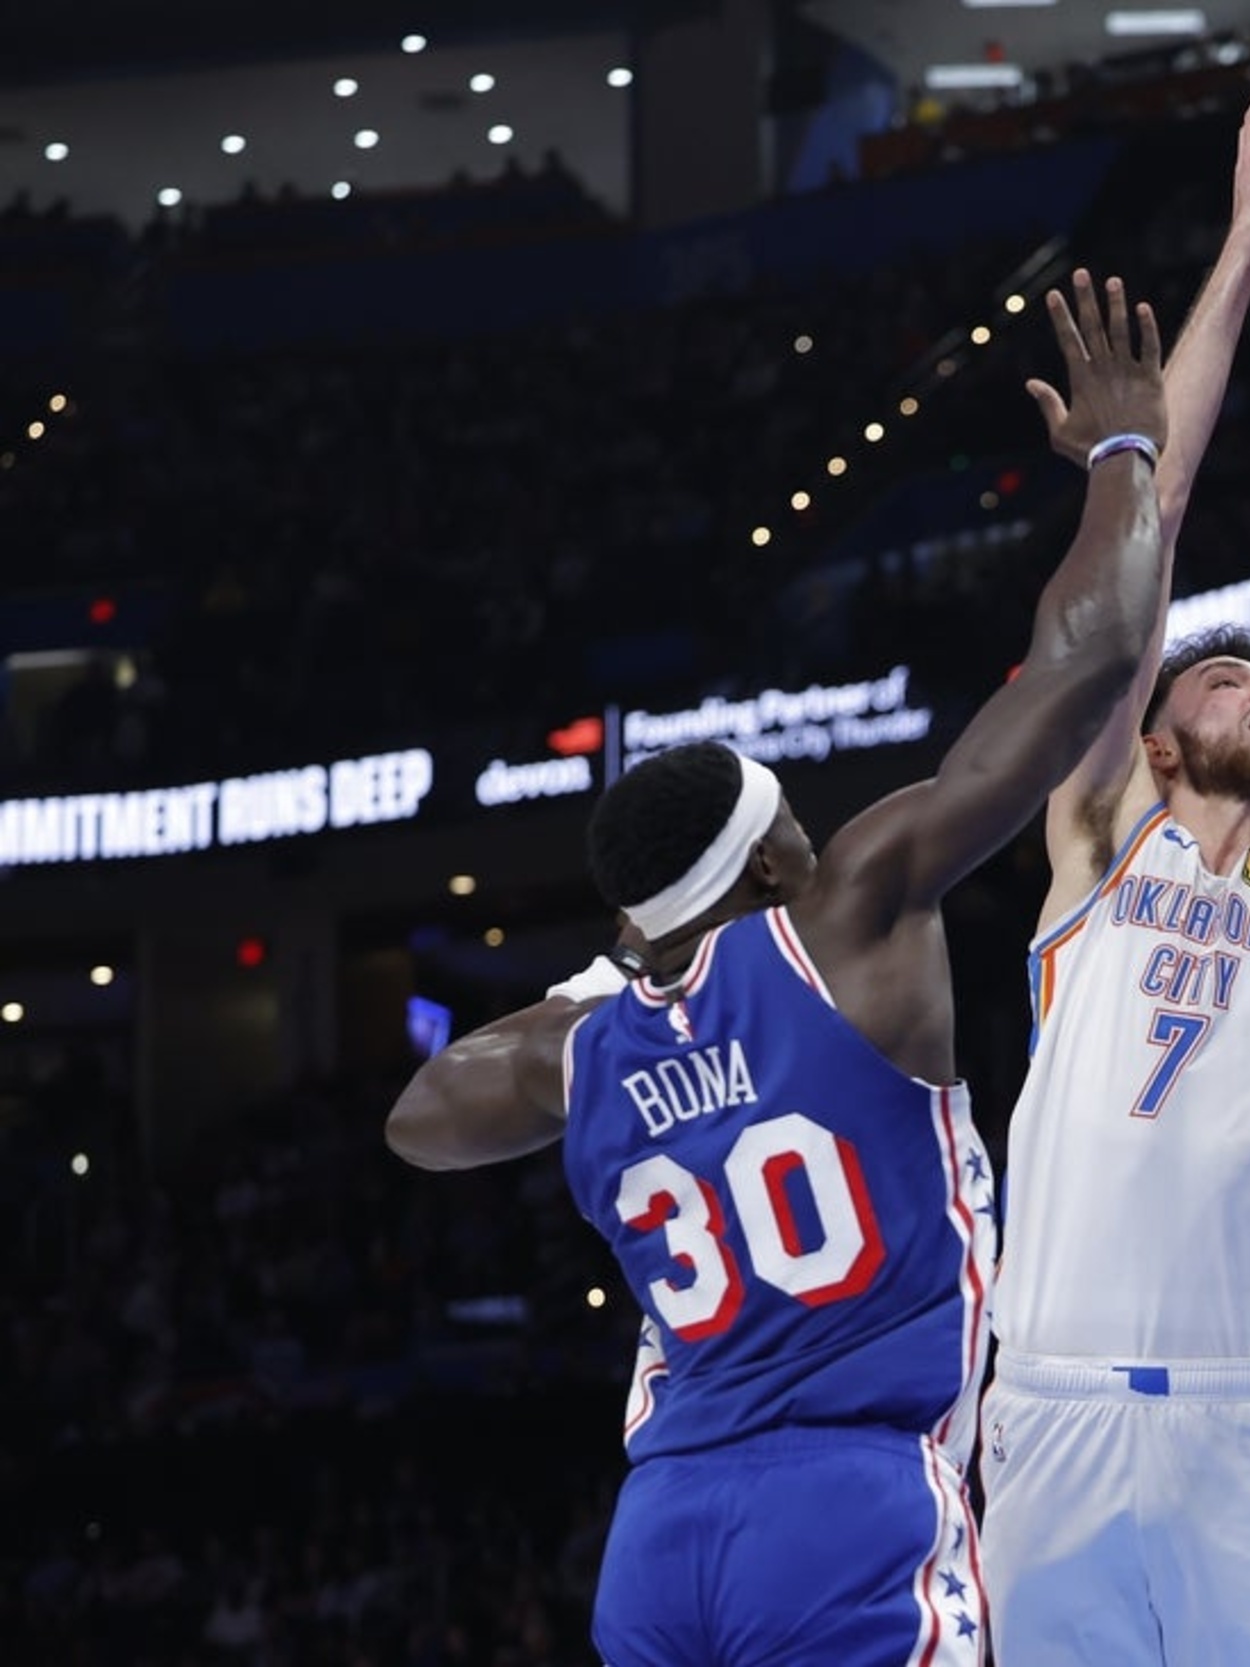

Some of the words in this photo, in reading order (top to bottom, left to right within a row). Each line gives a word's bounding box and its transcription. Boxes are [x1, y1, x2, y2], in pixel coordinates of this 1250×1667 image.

[624, 697, 759, 750] Founding
[759, 682, 869, 730] Partner
[329, 748, 432, 828] DEEP
[476, 755, 591, 805] devon
[1140, 944, 1240, 1010] CITY
[622, 1039, 758, 1137] BONA
[1130, 1008, 1210, 1119] 7
[615, 1112, 886, 1343] 30
